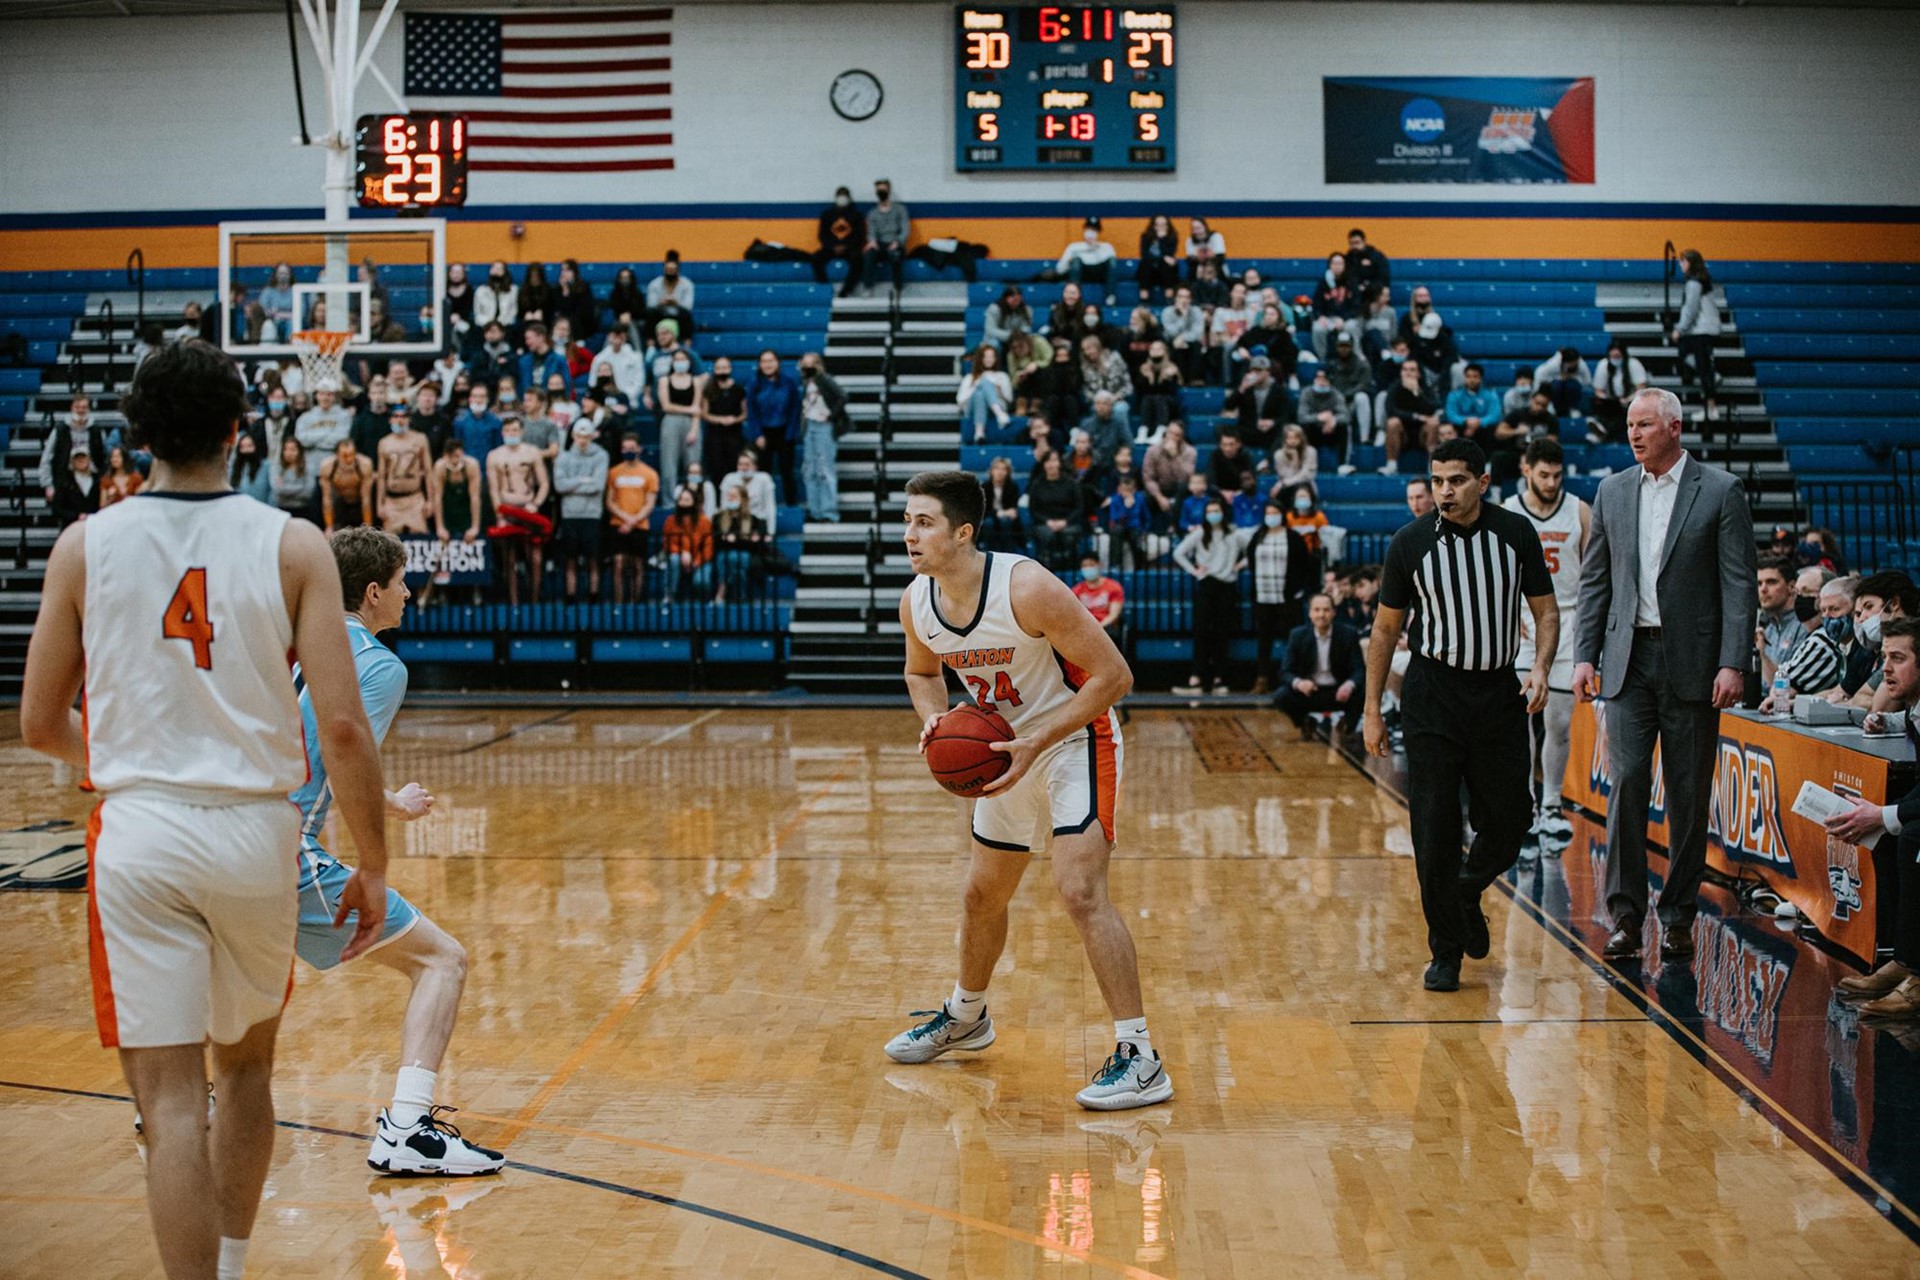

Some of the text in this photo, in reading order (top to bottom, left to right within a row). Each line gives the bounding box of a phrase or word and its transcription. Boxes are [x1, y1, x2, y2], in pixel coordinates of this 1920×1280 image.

[1039, 7, 1113, 42] 6:11
[966, 32, 1010, 68] 30
[1128, 32, 1173, 68] 27
[1103, 58, 1113, 83] 1
[384, 118, 462, 154] 6:11
[979, 113, 998, 141] 5
[1139, 113, 1160, 141] 5
[383, 154, 441, 202] 23
[162, 567, 214, 671] 4
[966, 671, 1023, 711] 24
